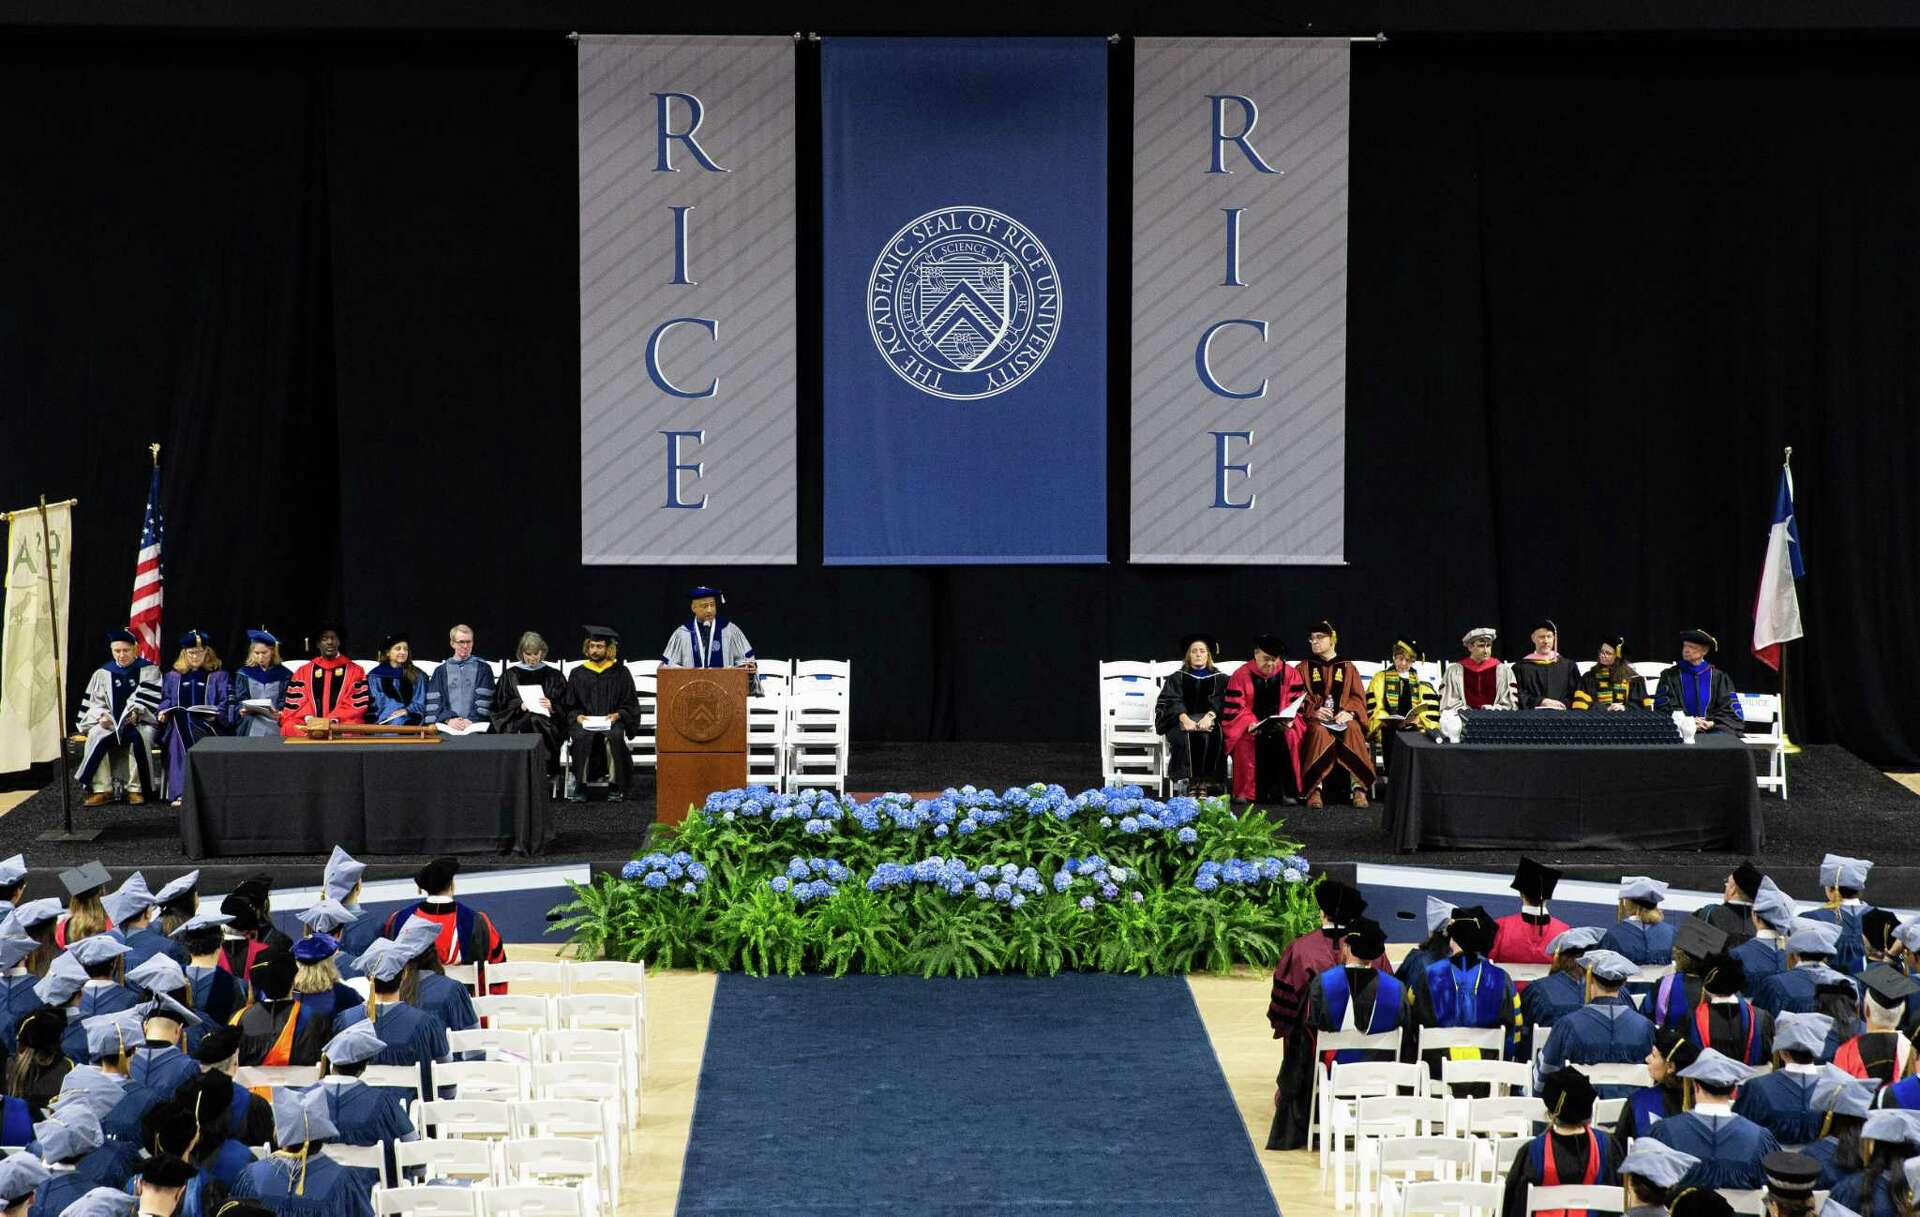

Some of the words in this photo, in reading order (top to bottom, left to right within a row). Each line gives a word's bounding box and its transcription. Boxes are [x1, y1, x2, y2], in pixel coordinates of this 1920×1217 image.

[911, 212, 962, 244] SEAL
[967, 212, 1000, 234] OF
[940, 242, 988, 256] SCIENCE
[1001, 226, 1047, 273] RICE
[644, 92, 733, 509] RICE
[873, 238, 913, 356] ACADEMIC
[901, 281, 915, 325] LETTERS
[1017, 293, 1028, 313] ART
[1195, 95, 1285, 509] RICE
[986, 275, 1057, 391] UNIVERSITY
[900, 355, 943, 391] THE
